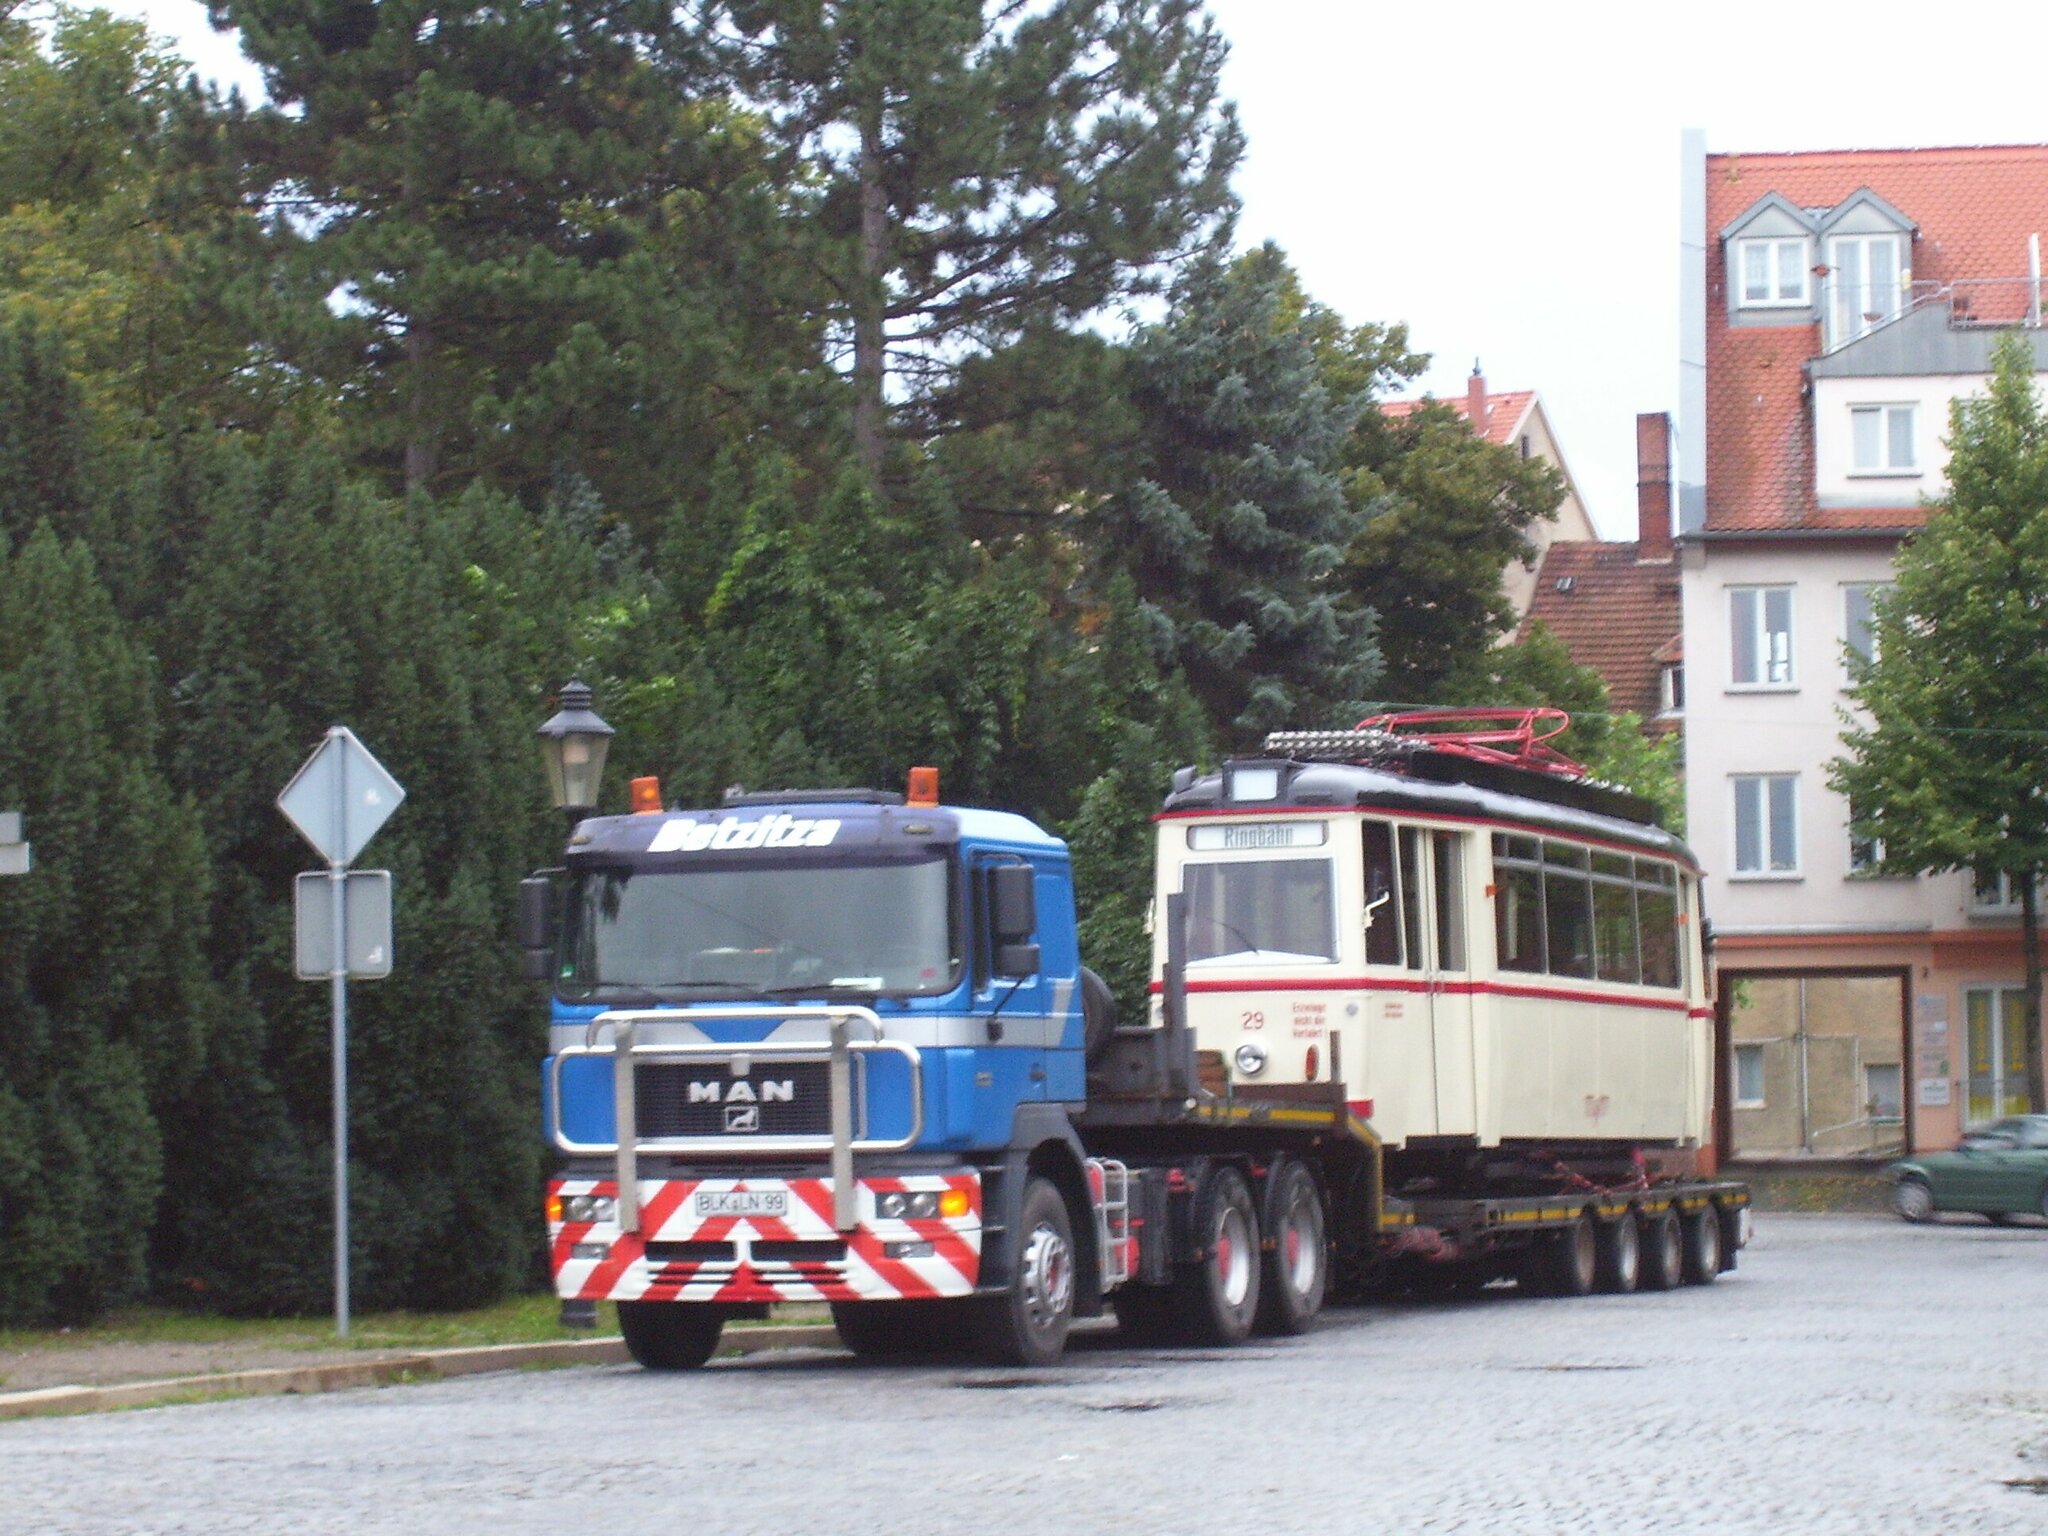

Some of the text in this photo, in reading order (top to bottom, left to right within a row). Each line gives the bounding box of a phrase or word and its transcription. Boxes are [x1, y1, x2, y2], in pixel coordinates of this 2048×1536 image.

[1224, 824, 1294, 847] Ringbahn
[1242, 1011, 1265, 1030] 29
[688, 1080, 794, 1102] MAN
